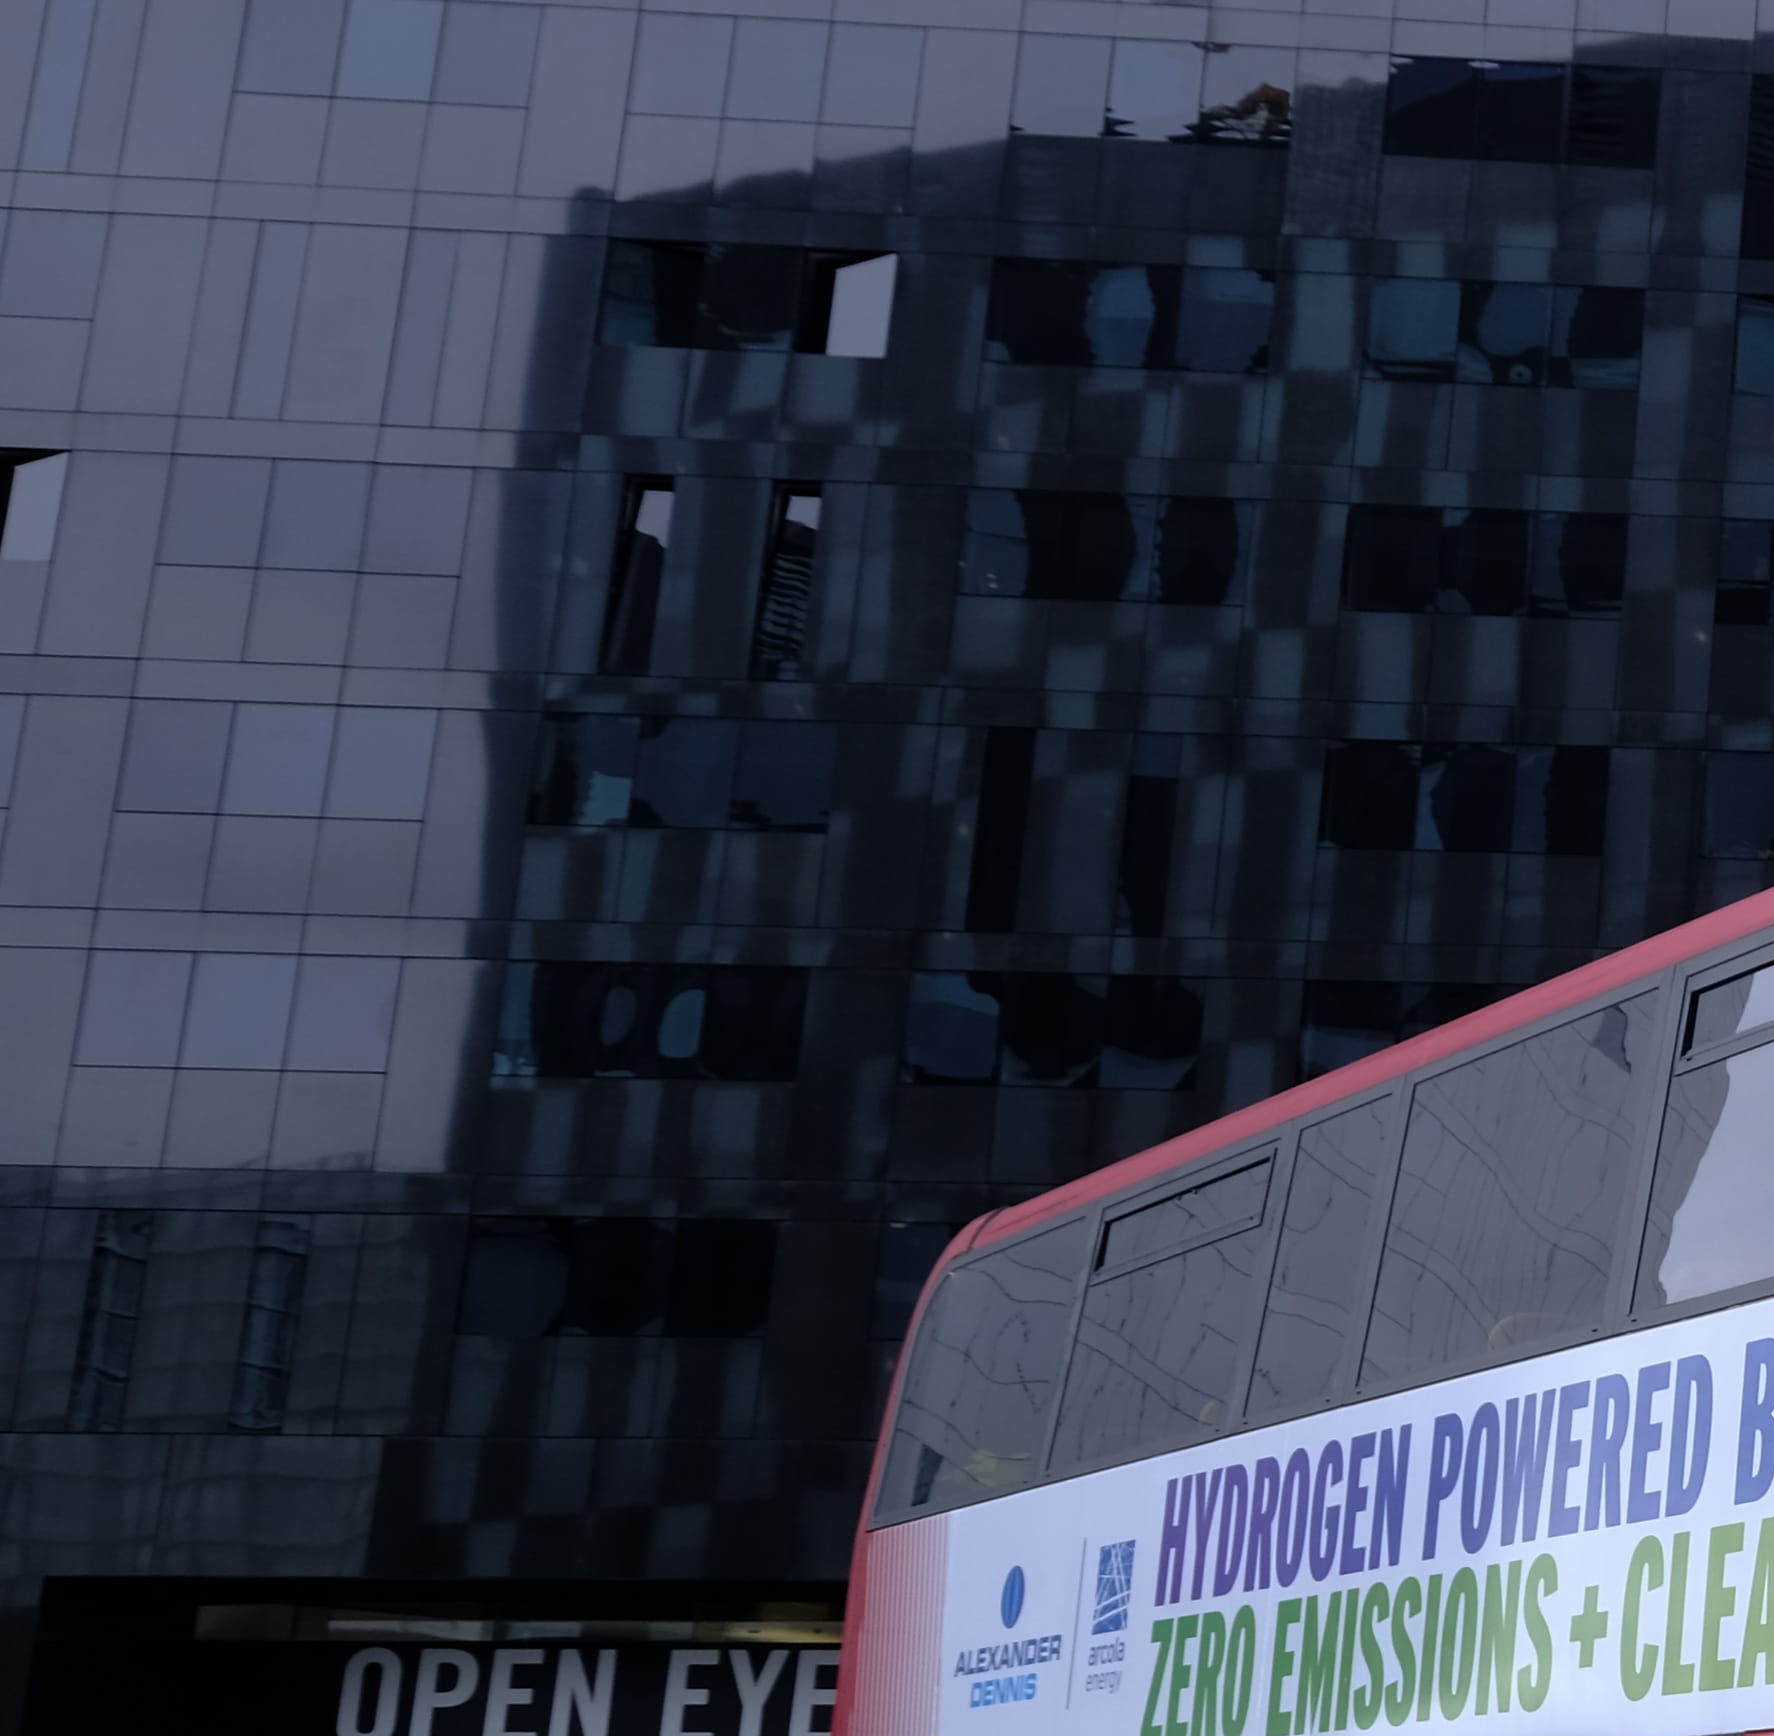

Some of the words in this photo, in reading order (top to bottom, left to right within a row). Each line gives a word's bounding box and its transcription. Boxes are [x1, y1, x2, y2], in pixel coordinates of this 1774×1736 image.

[1155, 1424, 1412, 1607] HYDROGEN
[1422, 1354, 1713, 1561] POWERED
[953, 1634, 1062, 1678] ALEXANDER
[1088, 1636, 1126, 1666] arcola
[969, 1673, 1037, 1708] DENNIS
